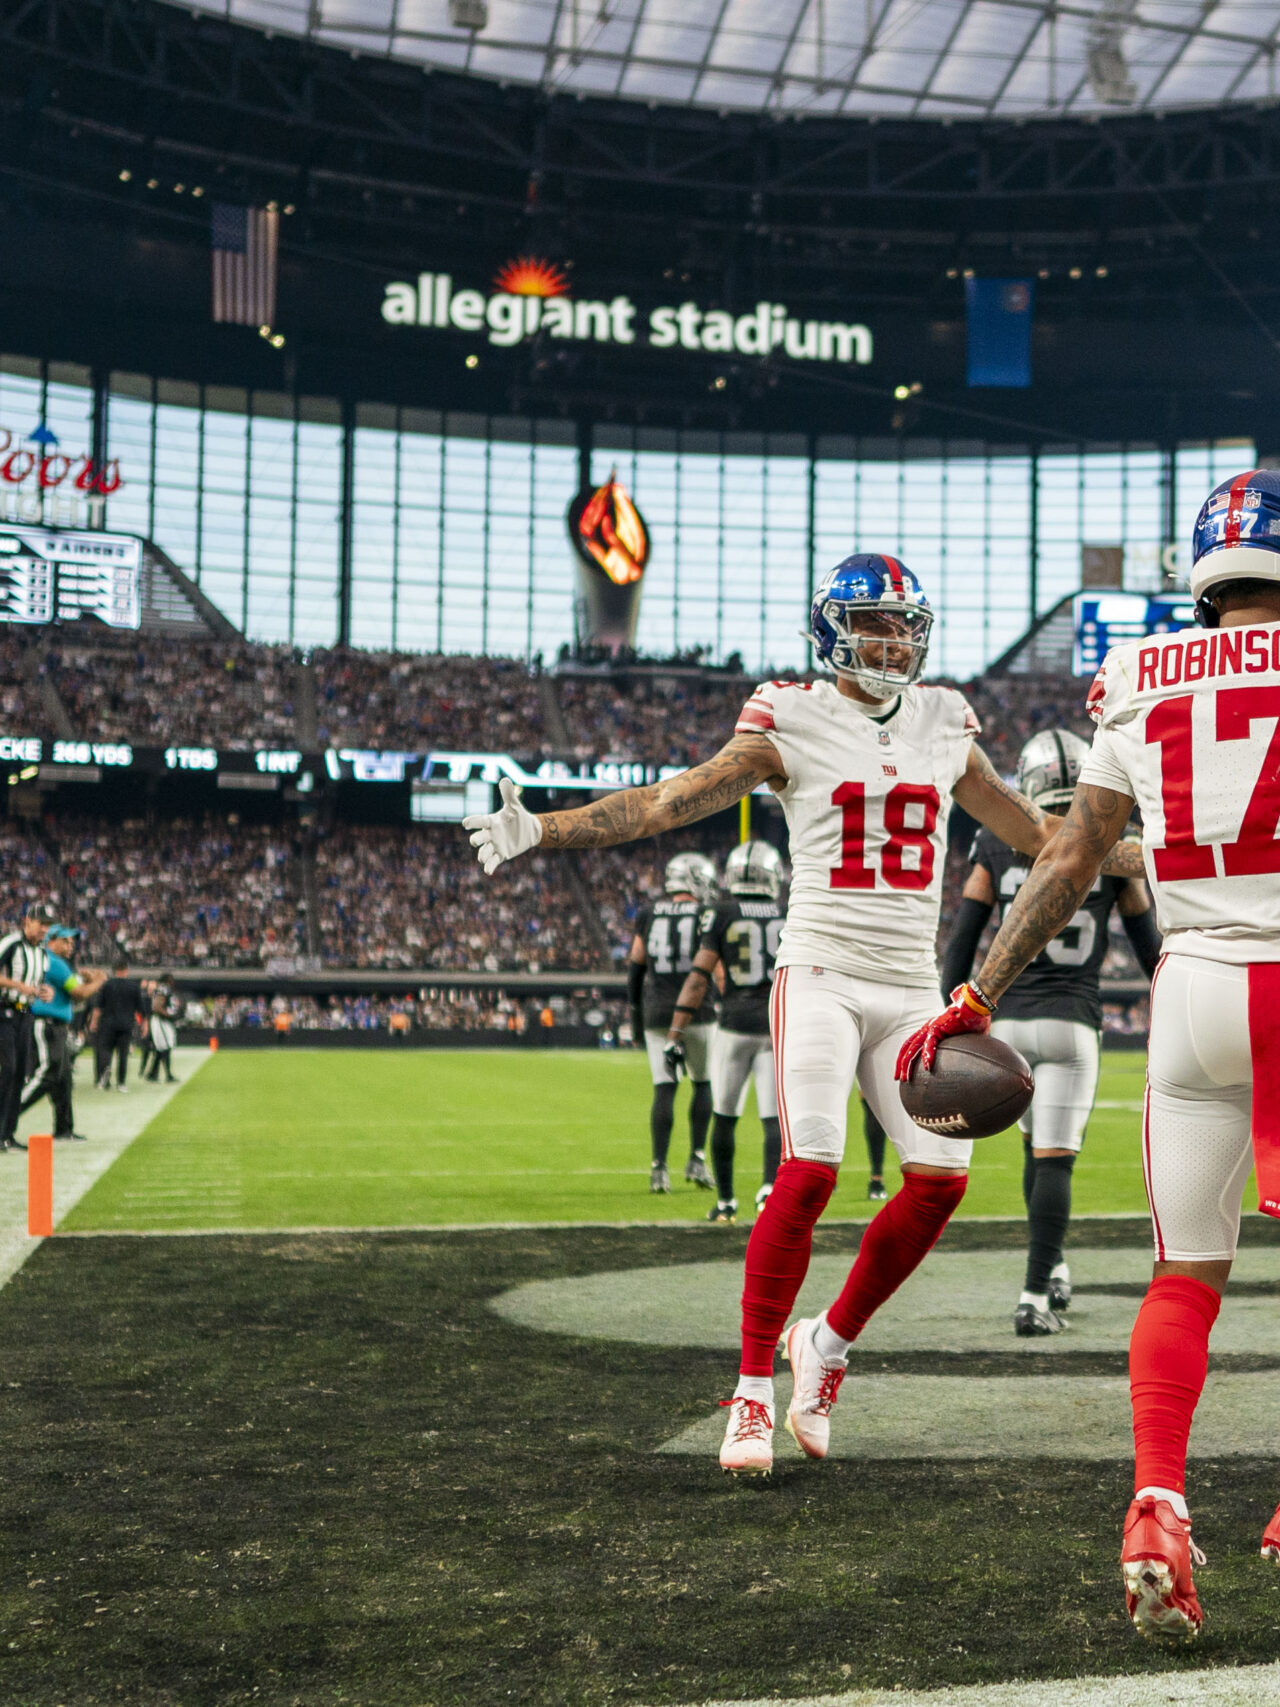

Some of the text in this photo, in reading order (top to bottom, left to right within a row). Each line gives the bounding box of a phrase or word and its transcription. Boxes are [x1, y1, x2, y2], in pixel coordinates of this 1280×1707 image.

[381, 272, 873, 364] allegiant stadium
[1214, 512, 1259, 542] 17
[830, 781, 940, 891] 18
[647, 917, 694, 974] 41
